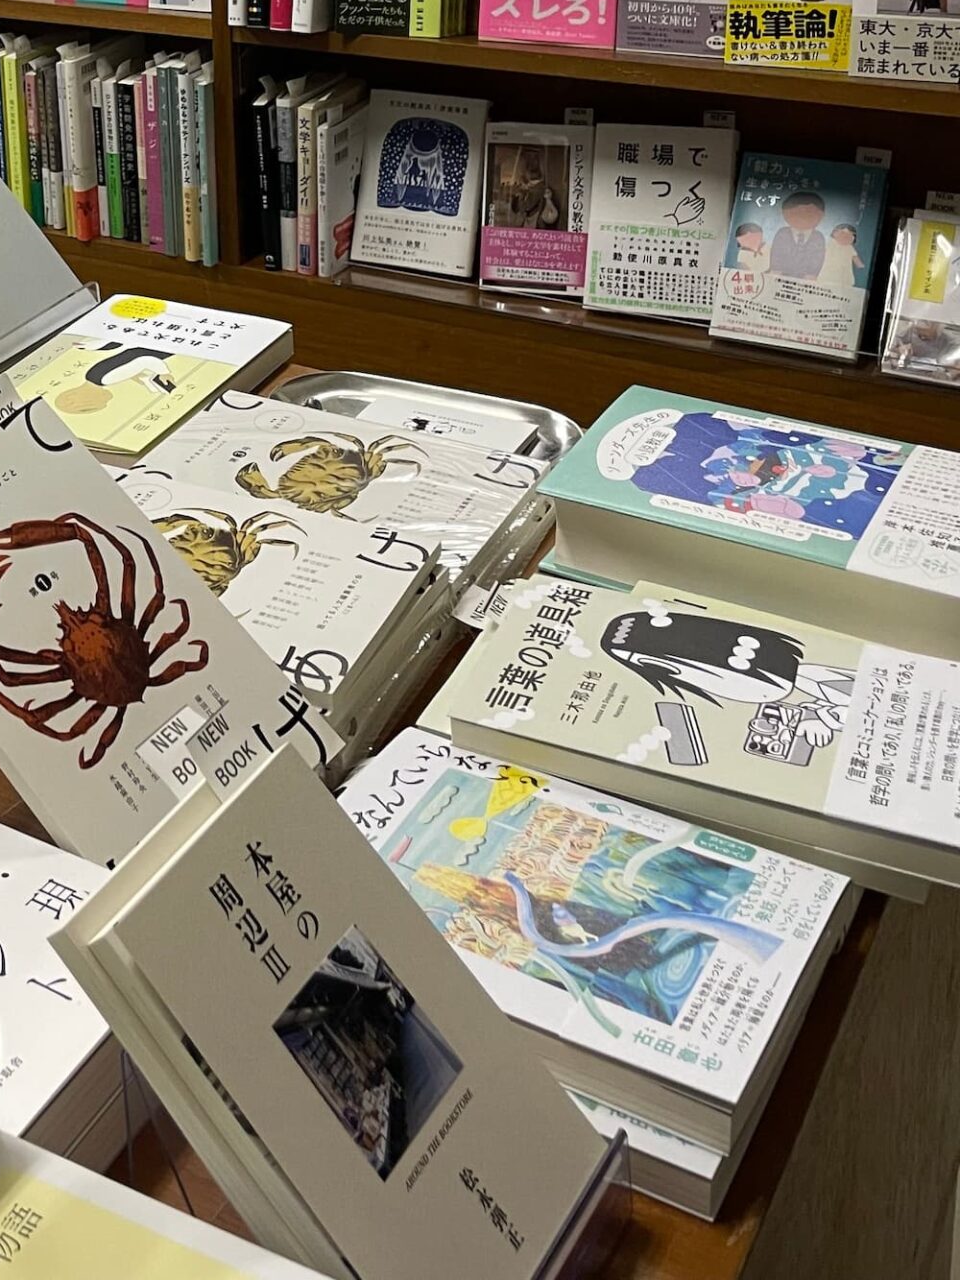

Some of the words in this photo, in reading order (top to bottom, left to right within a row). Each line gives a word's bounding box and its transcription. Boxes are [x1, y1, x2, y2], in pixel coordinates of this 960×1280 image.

[338, 15, 406, 27] ただの子供だった
[416, 7, 424, 32] LIFE
[728, 9, 839, 41] 執筆論!
[859, 39, 930, 59] いま一番
[617, 142, 709, 167] 職場で
[614, 175, 702, 201] 傷つく
[740, 191, 782, 208] ほぐす
[612, 251, 700, 269] 勅使川原真衣
[488, 594, 510, 618] NEW
[484, 583, 594, 714] 言葉の道具箱
[558, 670, 604, 727] 三木那由他
[150, 716, 188, 753] NEW
[196, 714, 230, 753] NEW
[842, 667, 891, 785] 「言葉とコミュニケーション」は
[213, 741, 258, 787] BOOK
[244, 839, 321, 941] 本屋の
[405, 1154, 430, 1194] AROUND
[438, 1087, 475, 1139] BOOKSTORE
